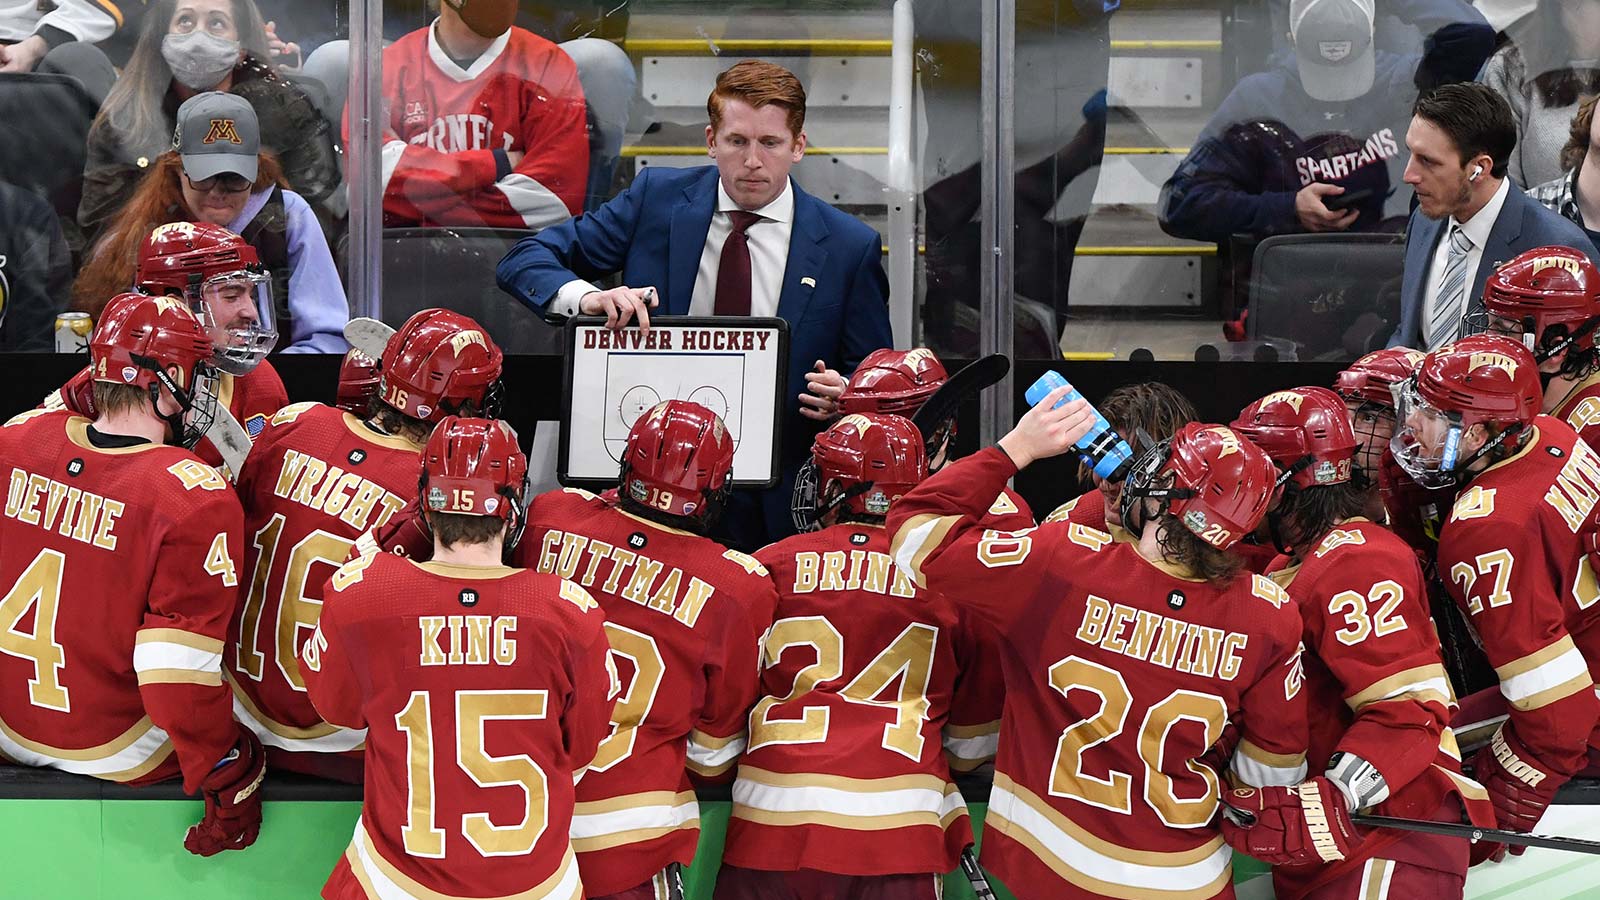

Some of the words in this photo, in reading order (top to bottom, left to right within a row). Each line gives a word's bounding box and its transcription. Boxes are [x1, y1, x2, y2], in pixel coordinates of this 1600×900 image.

[203, 119, 241, 144] M
[1296, 128, 1399, 186] SPARTANS
[1532, 256, 1583, 281] DENVER
[98, 357, 107, 377] 4
[584, 330, 672, 350] DENVER
[682, 331, 771, 351] HOCKEY
[389, 385, 409, 410] 16
[69, 462, 81, 474] RB
[274, 448, 408, 532] WRIGHT
[5, 467, 126, 551] DEVINE
[452, 489, 475, 511] 15
[650, 488, 673, 510] 19
[203, 532, 238, 588] 4
[632, 536, 644, 547] RB
[1202, 523, 1231, 546] 20
[236, 511, 356, 693] 16
[462, 592, 475, 603] RB
[537, 529, 716, 629] GUTTMAN
[1170, 594, 1183, 606] RB
[1450, 548, 1515, 617] 27
[0, 547, 71, 713] 4
[1075, 593, 1249, 682] BENNING
[1327, 579, 1409, 647] 32
[418, 615, 518, 667] KING
[746, 615, 940, 762] 24
[1048, 654, 1228, 830] 20
[394, 689, 549, 859] 15
